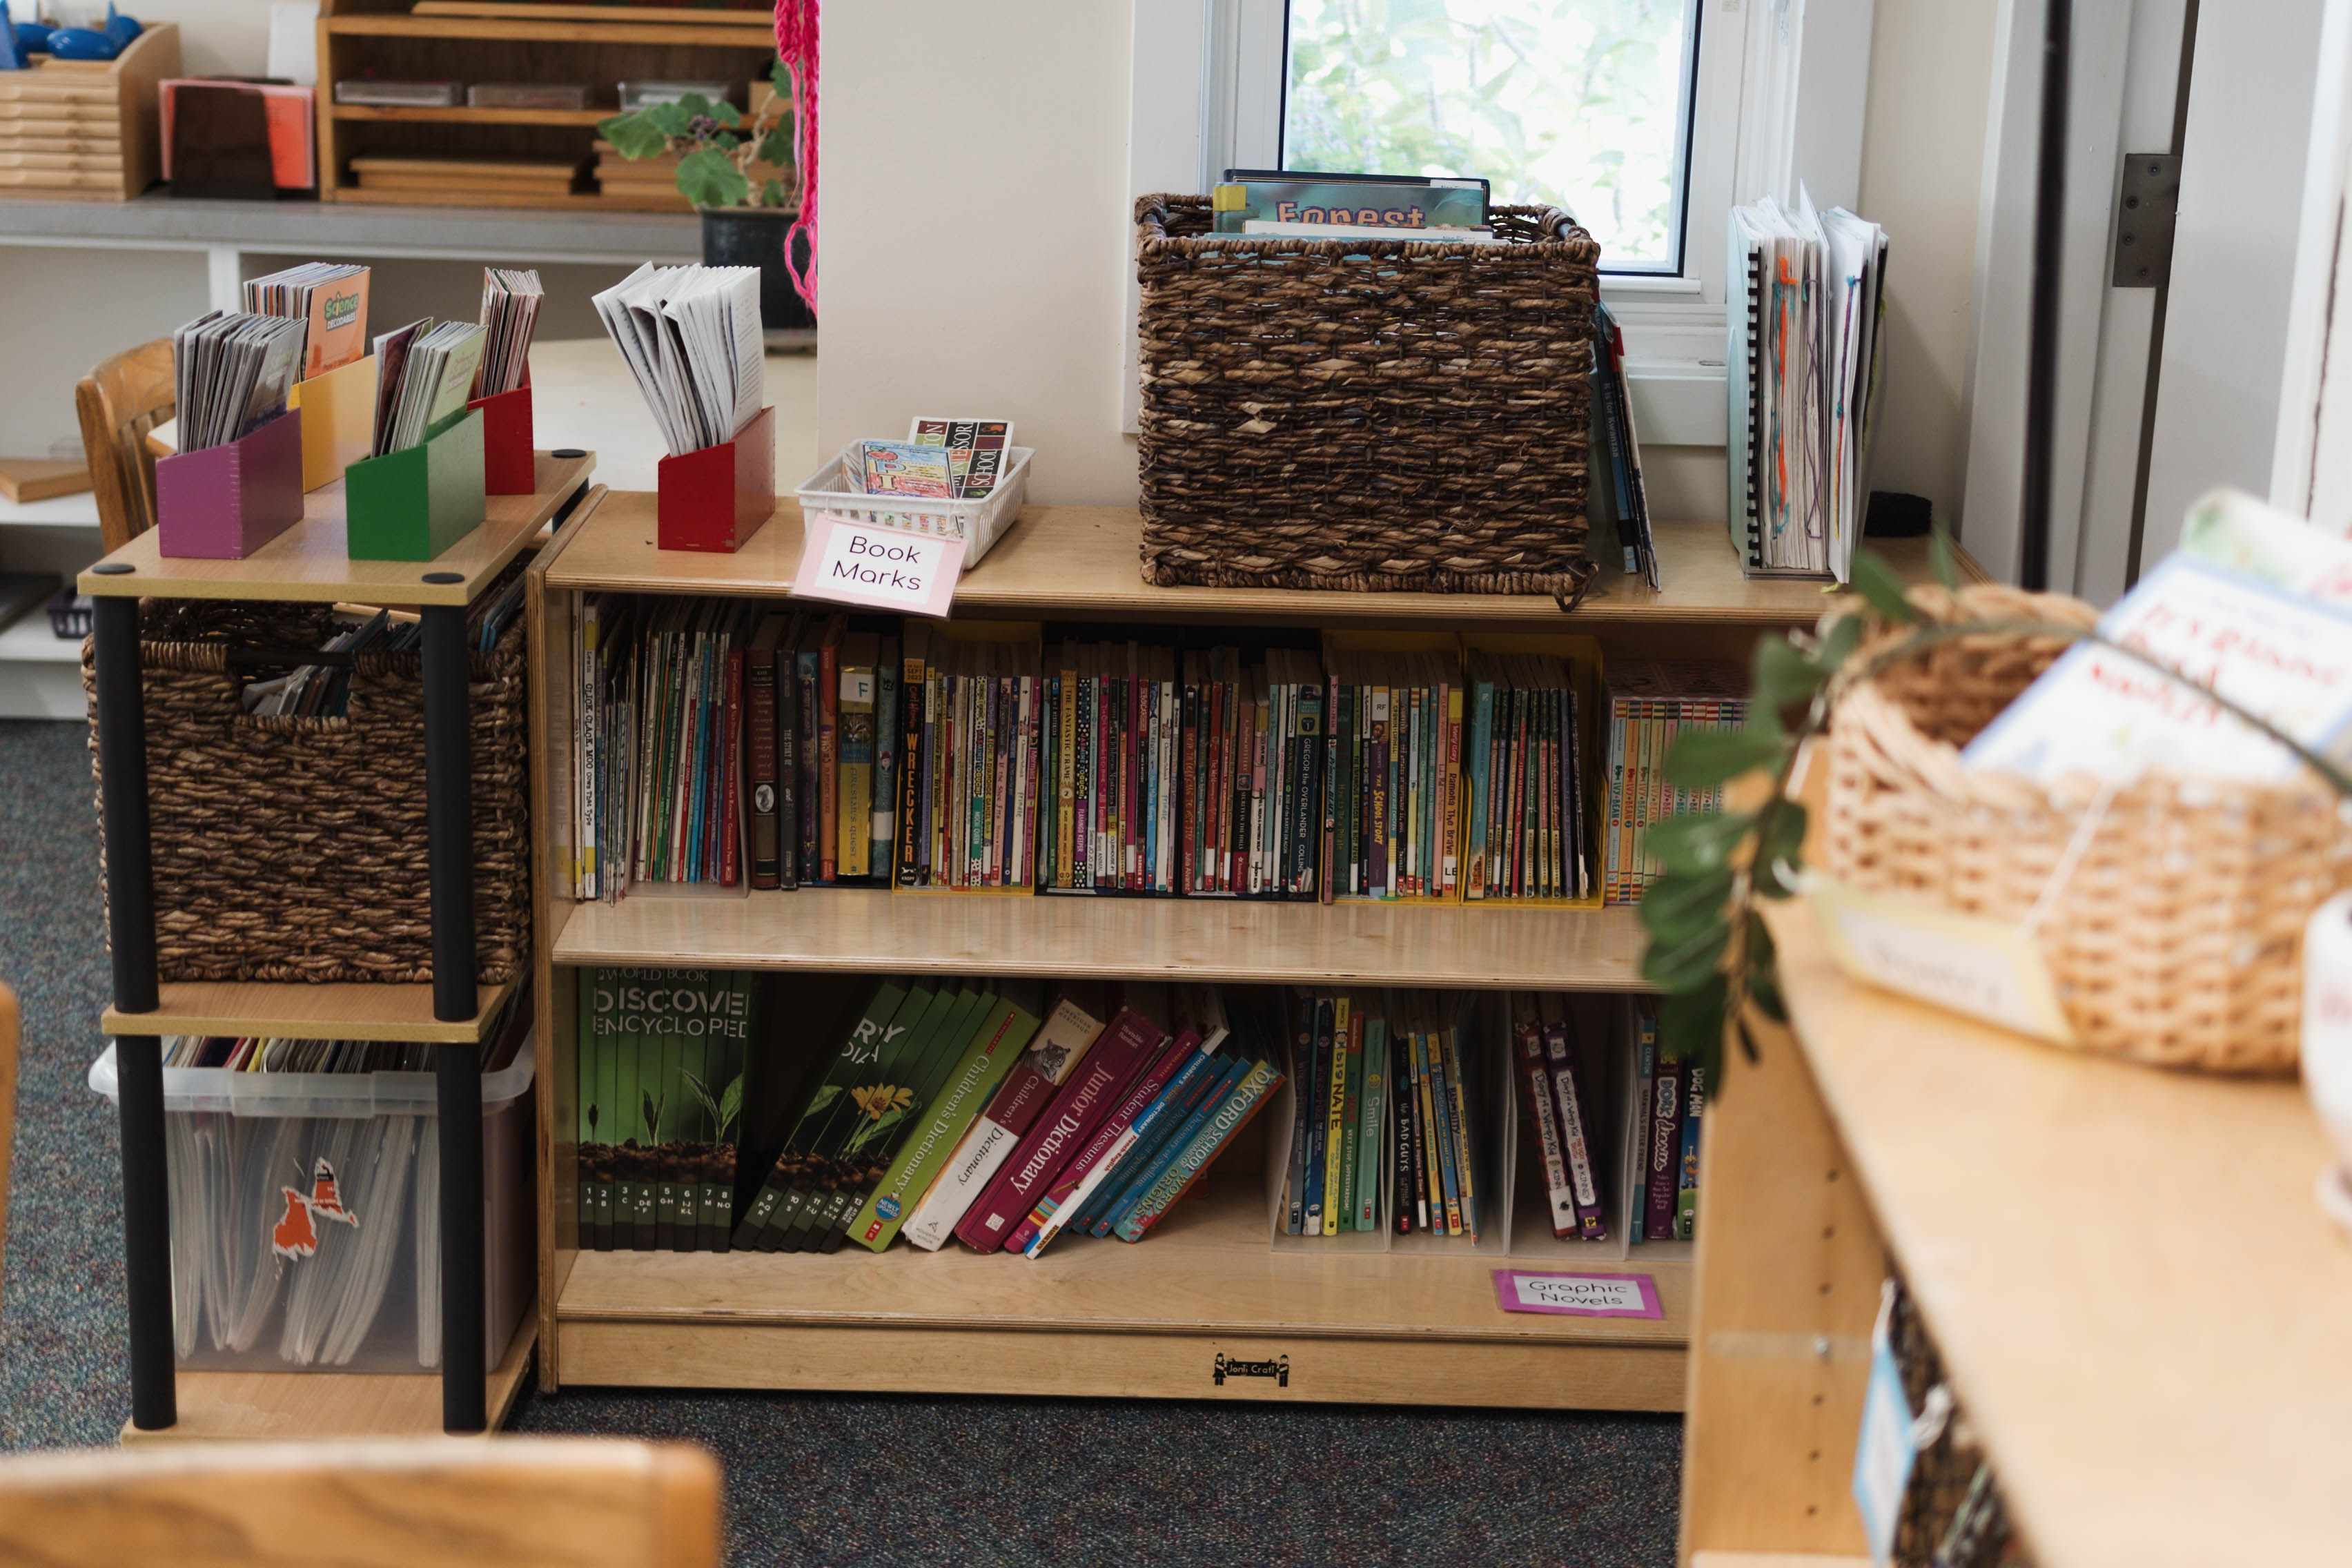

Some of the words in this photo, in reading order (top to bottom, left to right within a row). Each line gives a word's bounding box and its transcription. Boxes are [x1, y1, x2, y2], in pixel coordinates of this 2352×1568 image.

[325, 290, 359, 320] Science
[1603, 382, 1611, 391] K
[1606, 402, 1615, 414] for
[1607, 416, 1619, 458] Kwanzaa
[972, 450, 997, 485] SCHOOL
[850, 536, 921, 563] Book
[833, 560, 921, 590] Marks
[584, 684, 594, 713] CLICK,
[859, 682, 868, 698] F
[584, 715, 594, 747] CLACK,
[585, 750, 594, 769] MOO
[1302, 738, 1311, 771] GREGOR
[1450, 745, 1458, 761] Cleary
[905, 732, 919, 863] WRECKER
[1448, 773, 1457, 806] Ramona
[1611, 782, 1620, 794] IVY
[1625, 783, 1633, 796] IVY
[1638, 783, 1646, 796] IVY
[1651, 785, 1659, 798] IVY
[1663, 785, 1672, 798] IVY
[1299, 786, 1309, 838] OVERLANDER
[1373, 790, 1385, 820] SCHOOL
[1447, 810, 1456, 826] The
[1611, 798, 1620, 819] BEAN
[1624, 801, 1632, 819] BEAN
[1637, 800, 1645, 819] BEAN
[1649, 801, 1658, 821] BEAN
[1335, 827, 1344, 850] Pirate
[1374, 820, 1384, 845] STORY
[1446, 830, 1454, 854] Brave
[607, 968, 661, 981] WORLD
[667, 968, 707, 982] BOOK
[593, 986, 749, 1016] DISCOVE
[852, 1017, 906, 1043] RY
[1179, 1055, 1205, 1085] CHILDREN'S
[1690, 1068, 1706, 1091] DOG
[940, 1055, 990, 1123] Children's
[1076, 1061, 1115, 1116] Junior
[1448, 1087, 1458, 1104] BAD
[1535, 1073, 1547, 1097] Diary
[1658, 1079, 1676, 1117] DORK
[1000, 1075, 1039, 1126] Children's
[1119, 1079, 1160, 1121] Student
[1215, 1069, 1271, 1130] OXFORD
[1331, 1084, 1344, 1130] NATE
[1346, 1095, 1356, 1123] NATE
[1560, 1077, 1571, 1095] Diary
[1567, 1108, 1577, 1127] Wimpy
[1640, 1089, 1649, 1124] NARWHAL'S
[1689, 1094, 1703, 1117] MAN
[1137, 1101, 1165, 1133] DICTIONARY
[1168, 1112, 1204, 1148] Dictionary
[1365, 1097, 1380, 1137] Smile
[1400, 1118, 1409, 1140] BAD
[1451, 1112, 1460, 1135] KITTY
[1542, 1115, 1554, 1141] Wimpy
[1076, 1121, 1126, 1173] Thesaurus
[1187, 1126, 1214, 1157] DICTIONARY
[1547, 1141, 1558, 1156] Kid
[1639, 1125, 1647, 1148] OTTER
[1654, 1119, 1675, 1171] diaries
[895, 1119, 949, 1190] Dictionary
[958, 1127, 1003, 1186] Dictionary
[1010, 1113, 1081, 1197] Dictionary
[1104, 1136, 1137, 1171] French-English
[1179, 1155, 1190, 1167] OF
[1188, 1130, 1222, 1171] SCHOOL
[1400, 1143, 1409, 1172] GUYS
[1135, 1168, 1179, 1215] ORIGINS
[1156, 1173, 1188, 1210] WORD
[1579, 1171, 1589, 1200] KINNEY
[790, 1195, 799, 1204] 10
[835, 1197, 843, 1205] 12
[854, 1197, 863, 1206] 13
[876, 1203, 897, 1217] UPDATED
[880, 1198, 899, 1211] NEWLY
[846, 1208, 857, 1223] ATLAS
[1529, 1282, 1627, 1293] Graphic
[1541, 1293, 1623, 1305] Novels
